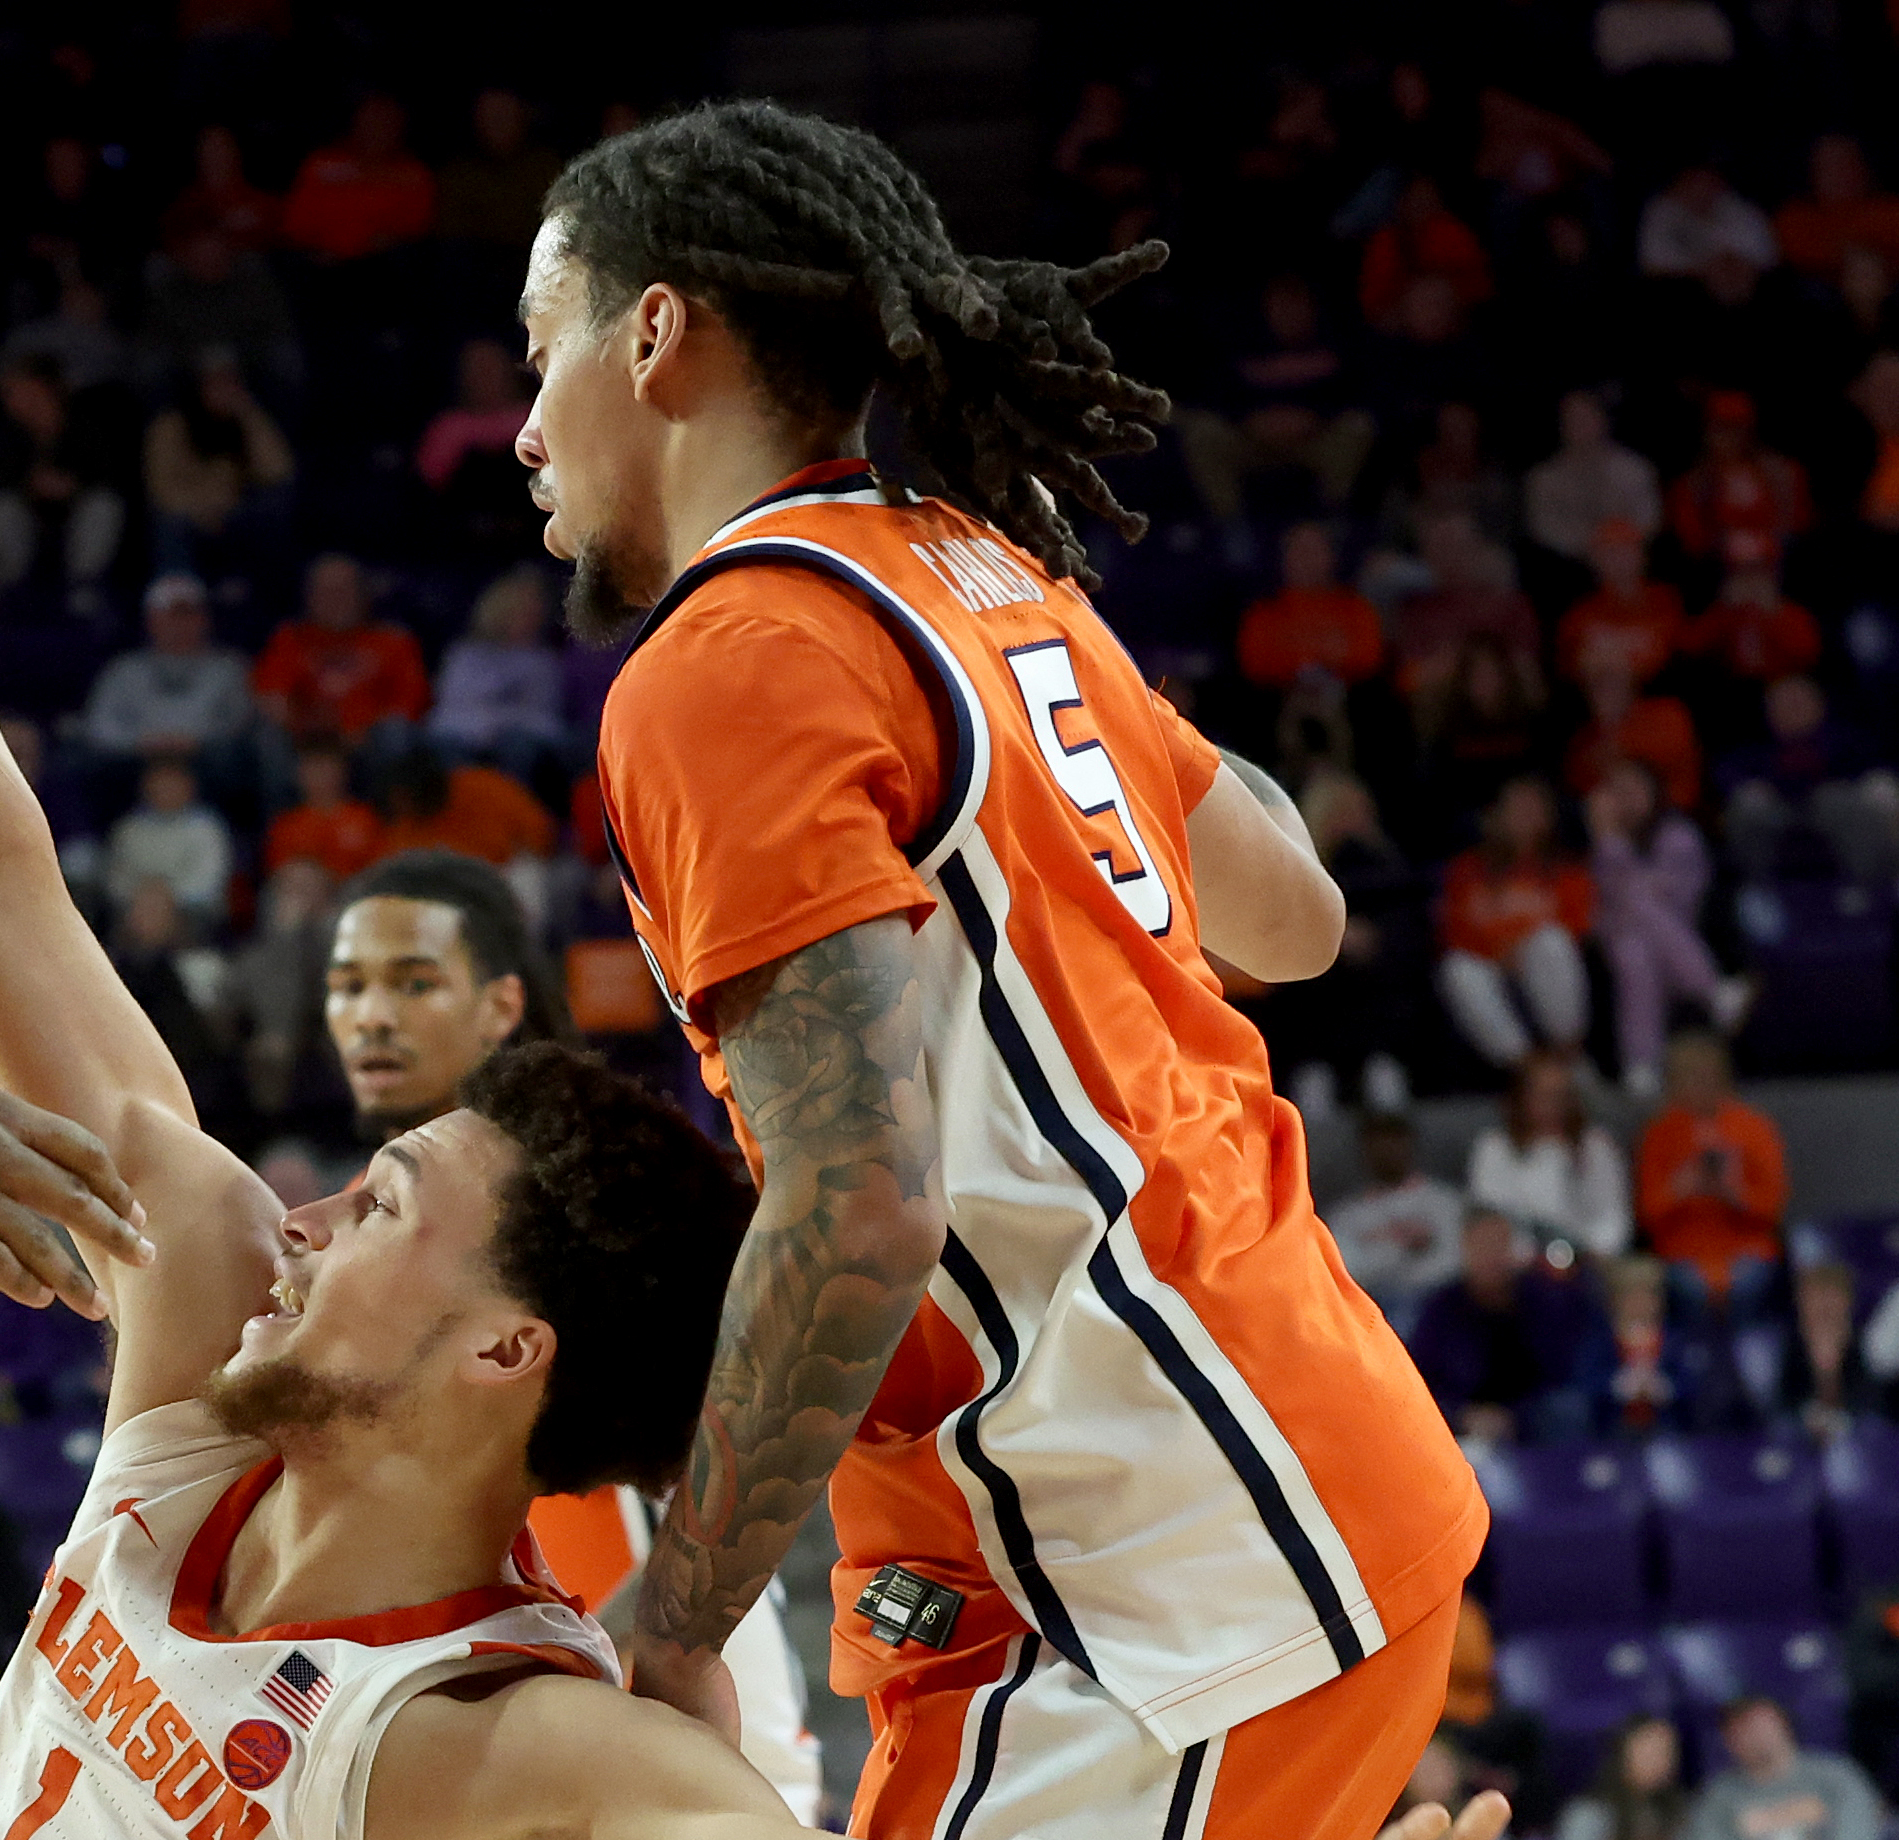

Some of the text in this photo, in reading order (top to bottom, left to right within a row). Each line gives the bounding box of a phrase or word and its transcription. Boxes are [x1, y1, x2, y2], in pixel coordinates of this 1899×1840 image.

[908, 537, 1045, 613] CARLOS
[1003, 638, 1173, 939] 5
[921, 1601, 941, 1627] 46
